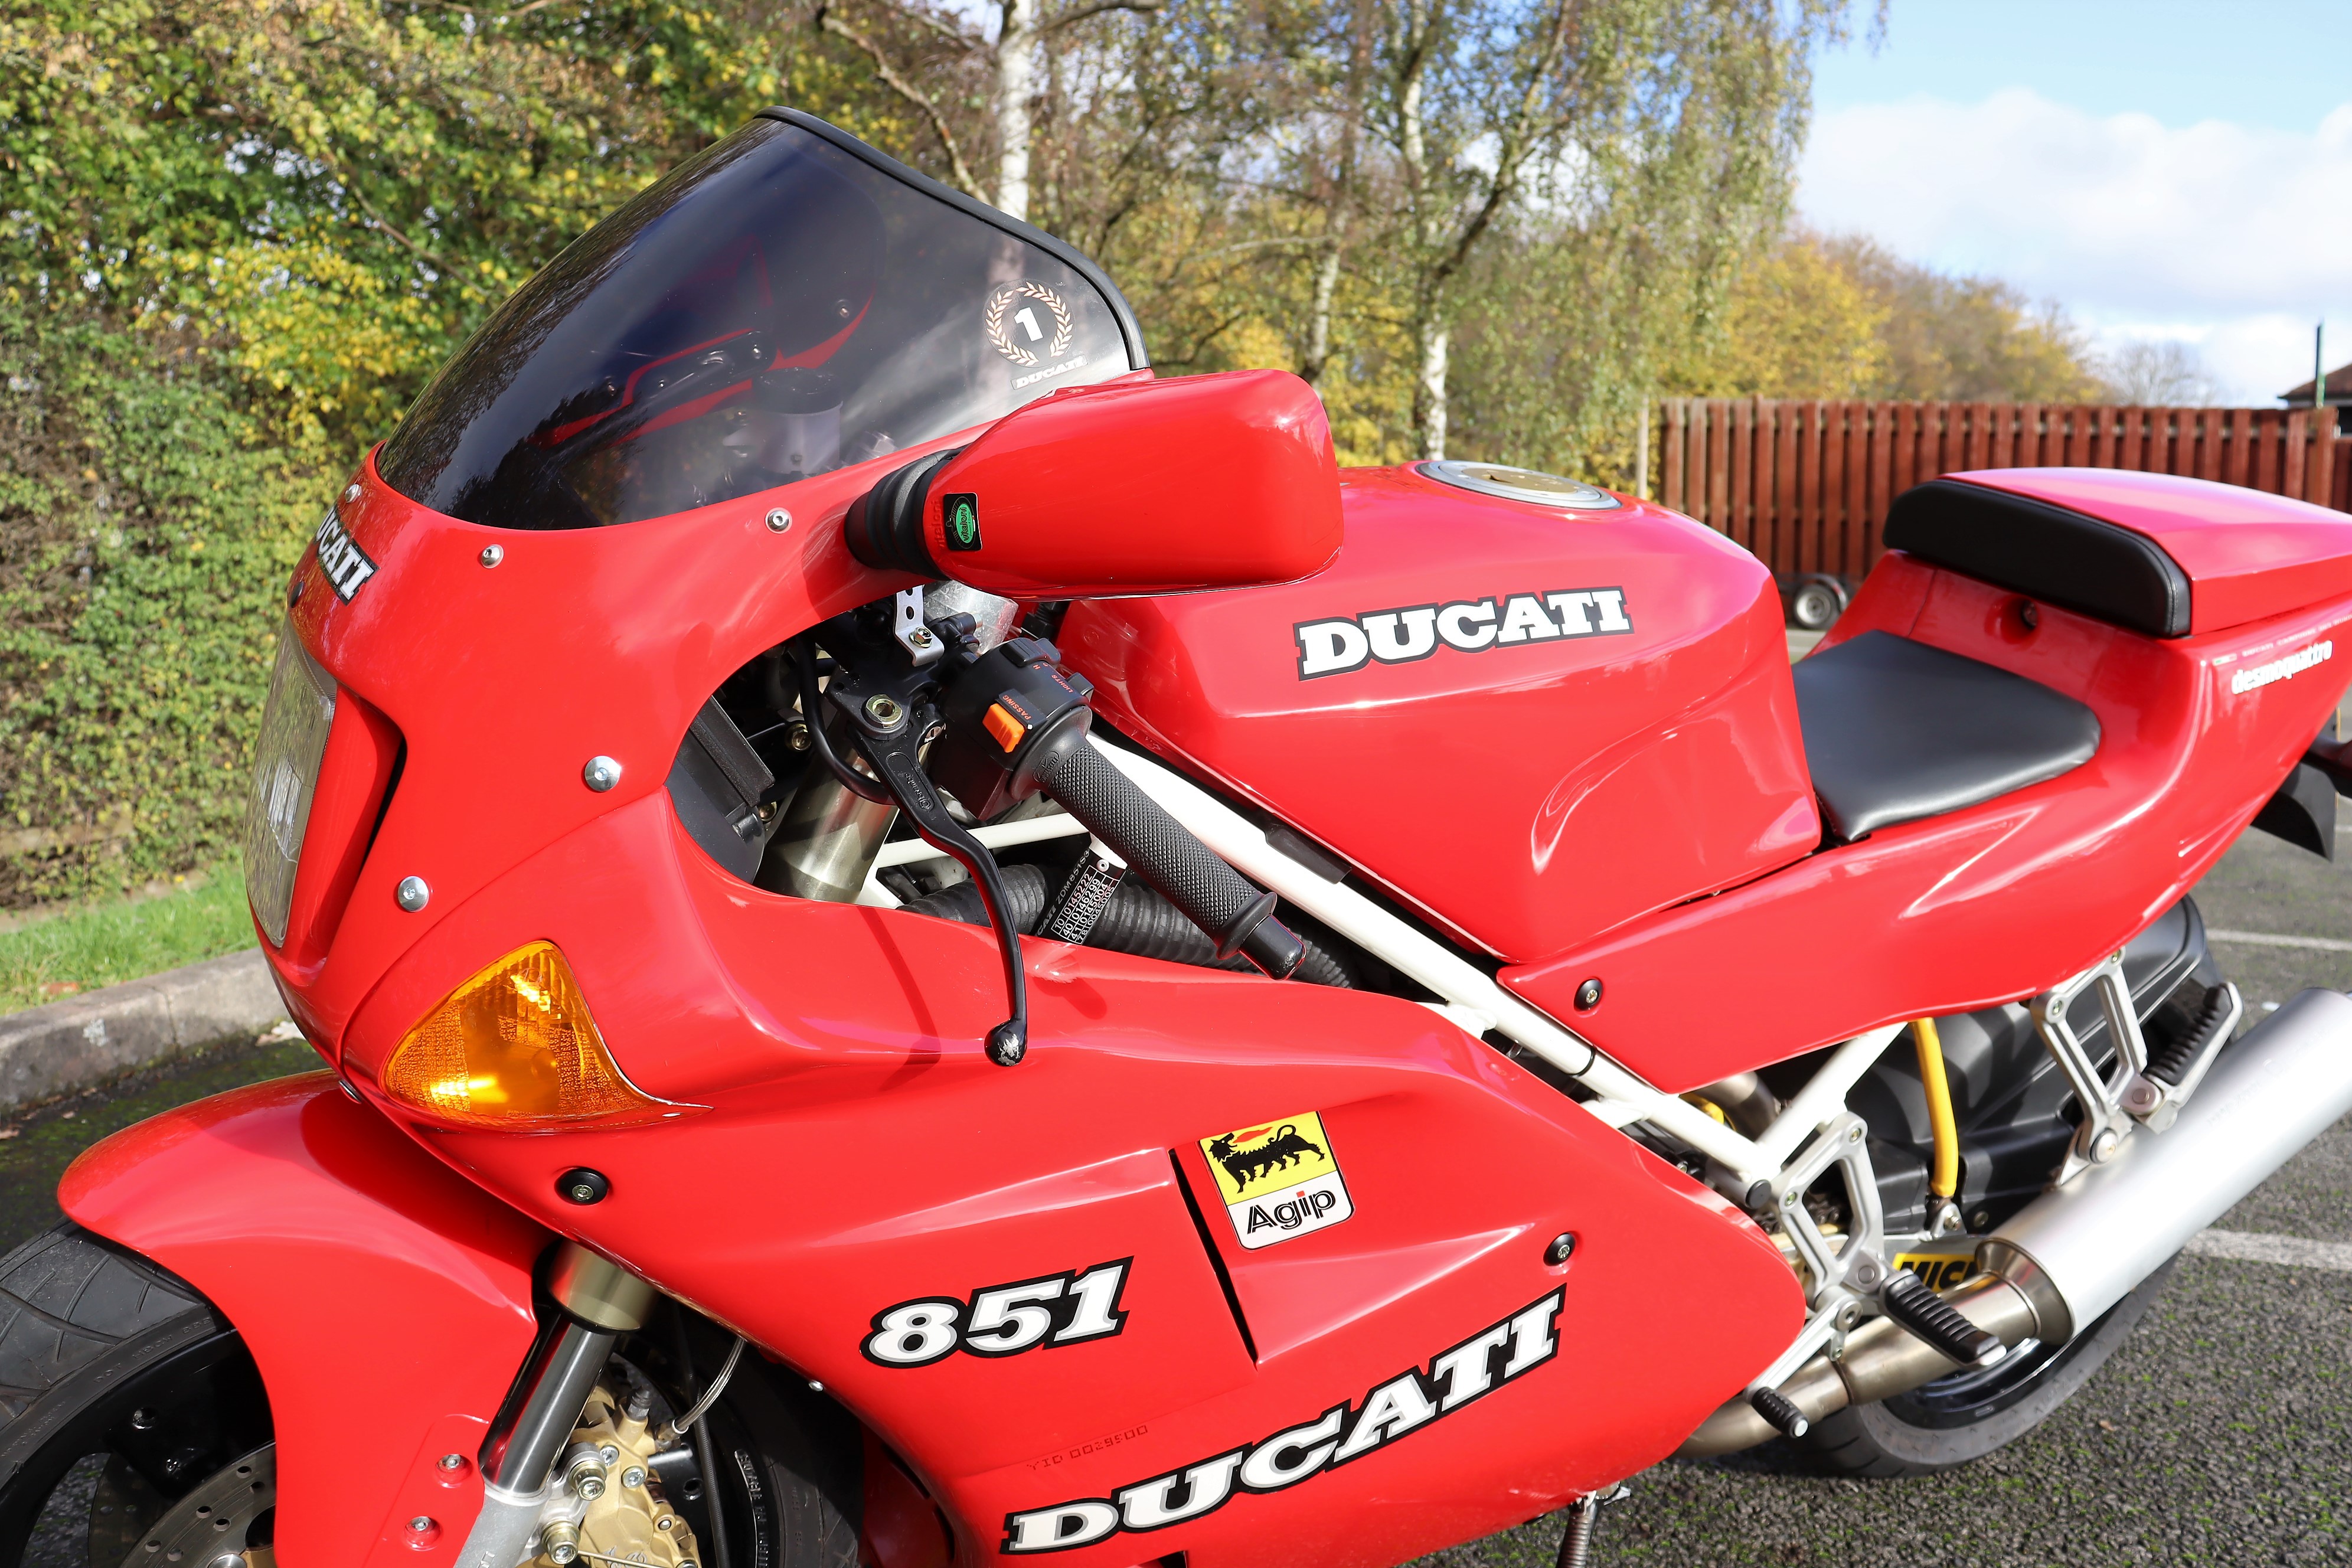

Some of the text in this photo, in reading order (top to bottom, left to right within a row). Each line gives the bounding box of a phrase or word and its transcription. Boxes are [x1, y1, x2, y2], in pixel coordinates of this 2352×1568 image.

[1013, 306, 1044, 342] 1
[1015, 355, 1086, 388] DUCATI
[959, 507, 970, 541] vitaloni
[315, 506, 375, 600] UCATI
[1296, 589, 1632, 677] DUCATI
[1051, 674, 1074, 692] LIGHTS
[2231, 640, 2333, 695] desmoquattro
[1002, 695, 1032, 720] PASSING
[1034, 904, 1057, 936] CATI
[1054, 873, 1093, 930] 10 0145222
[1063, 878, 1100, 936] 40 0146299
[1071, 883, 1109, 939] 41 0145004
[1077, 886, 1115, 941] 78 0045005
[1247, 1190, 1336, 1234] Agip
[868, 1265, 1123, 1363] 851
[93, 1363, 122, 1383] DOT
[1007, 1292, 1560, 1551] DUCATI
